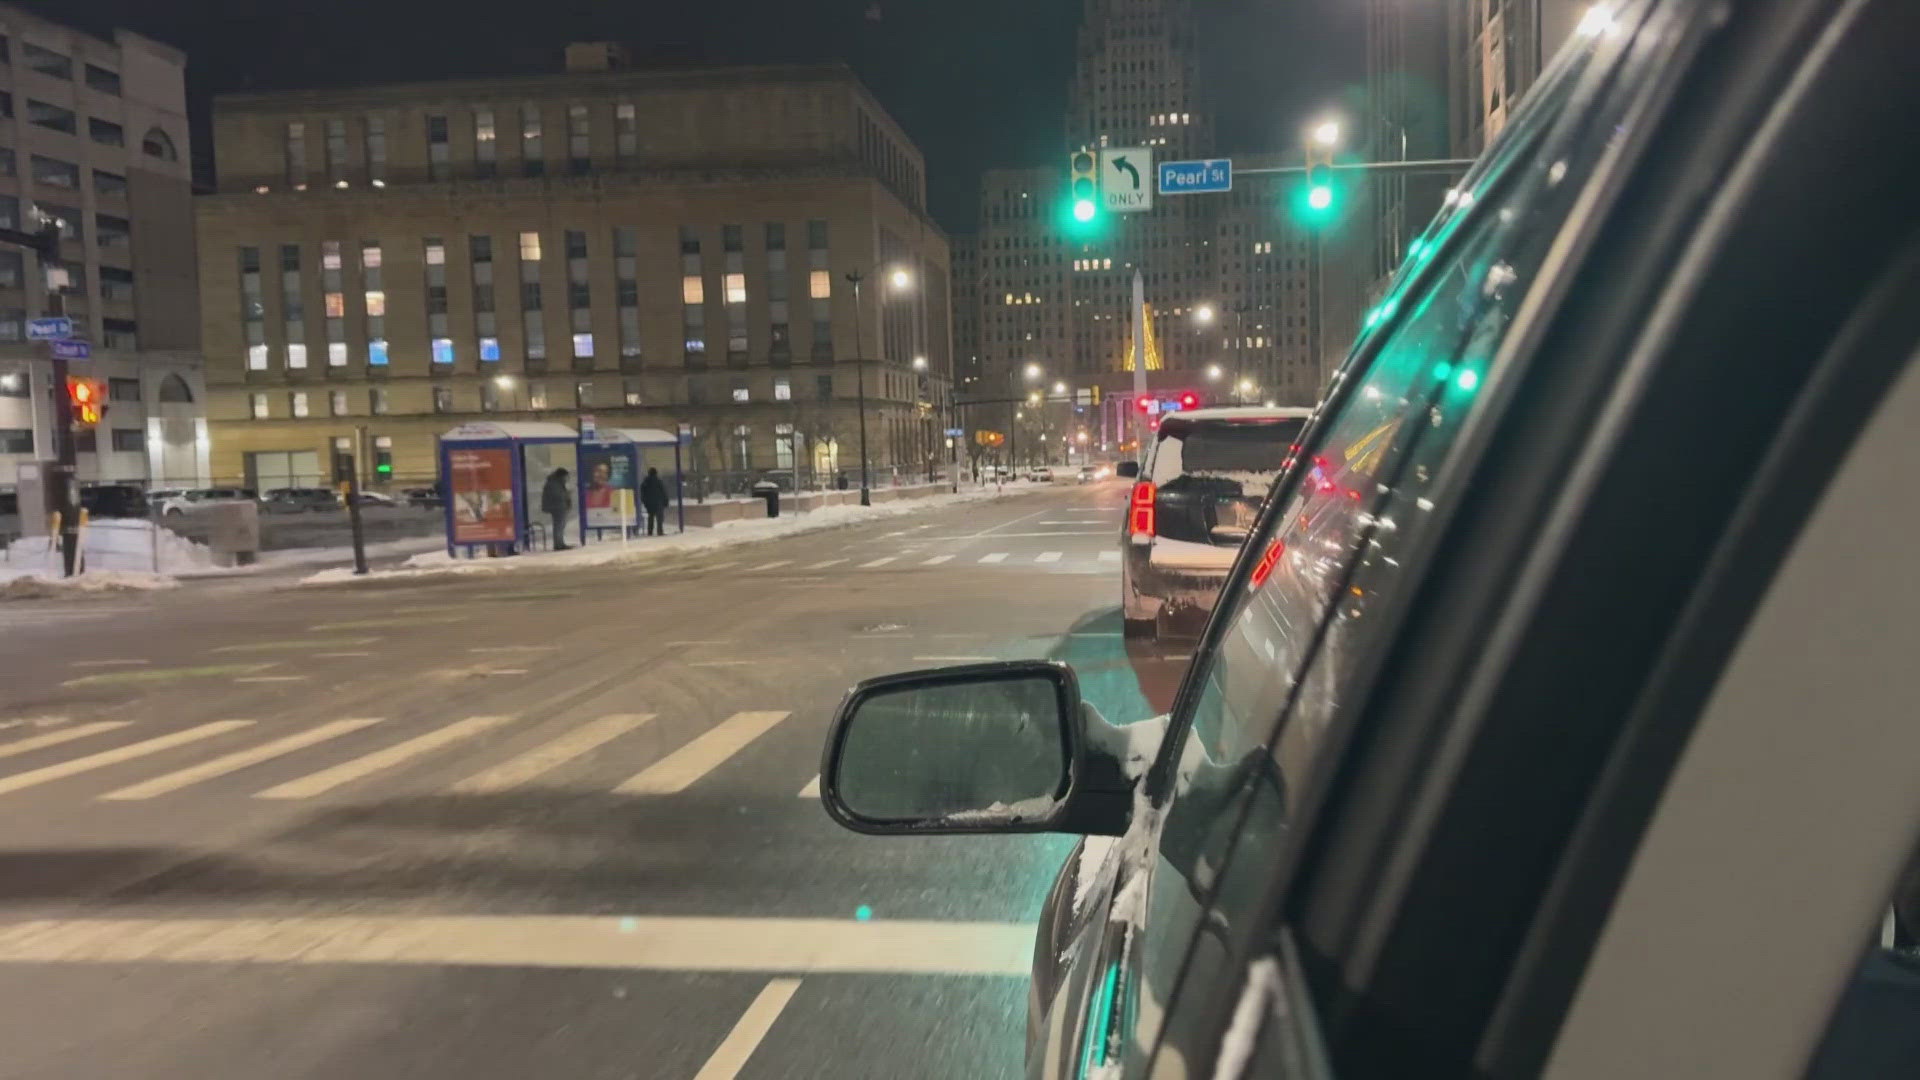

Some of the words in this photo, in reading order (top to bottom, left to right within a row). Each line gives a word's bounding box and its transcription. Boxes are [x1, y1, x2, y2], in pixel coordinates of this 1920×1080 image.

[1165, 169, 1207, 186] Pearl
[1212, 168, 1225, 182] St
[1109, 192, 1144, 205] ONLY
